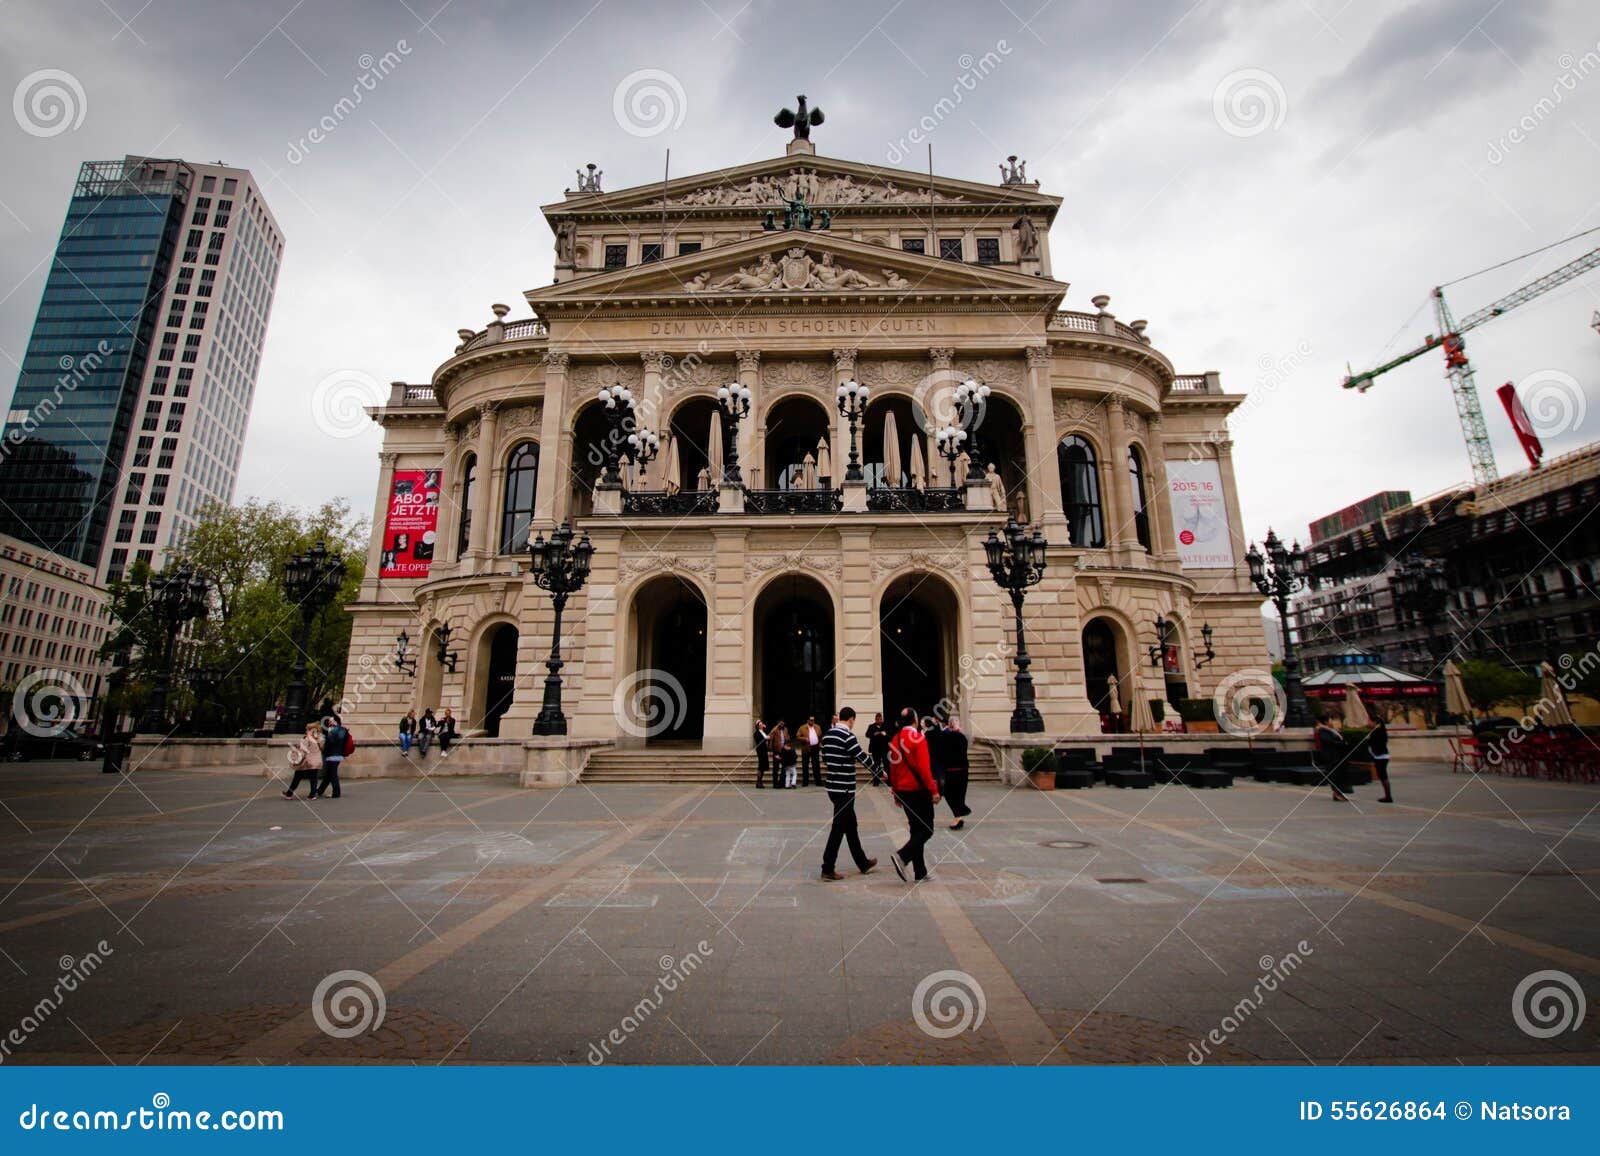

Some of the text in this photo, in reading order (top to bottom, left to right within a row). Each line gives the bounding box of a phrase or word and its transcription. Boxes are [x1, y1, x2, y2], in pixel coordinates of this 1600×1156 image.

[651, 322, 686, 336] DEM
[696, 321, 769, 335] WAHREN
[778, 319, 871, 333] SCHOENEN
[393, 493, 424, 504] ABO
[391, 505, 436, 515] JETZT!
